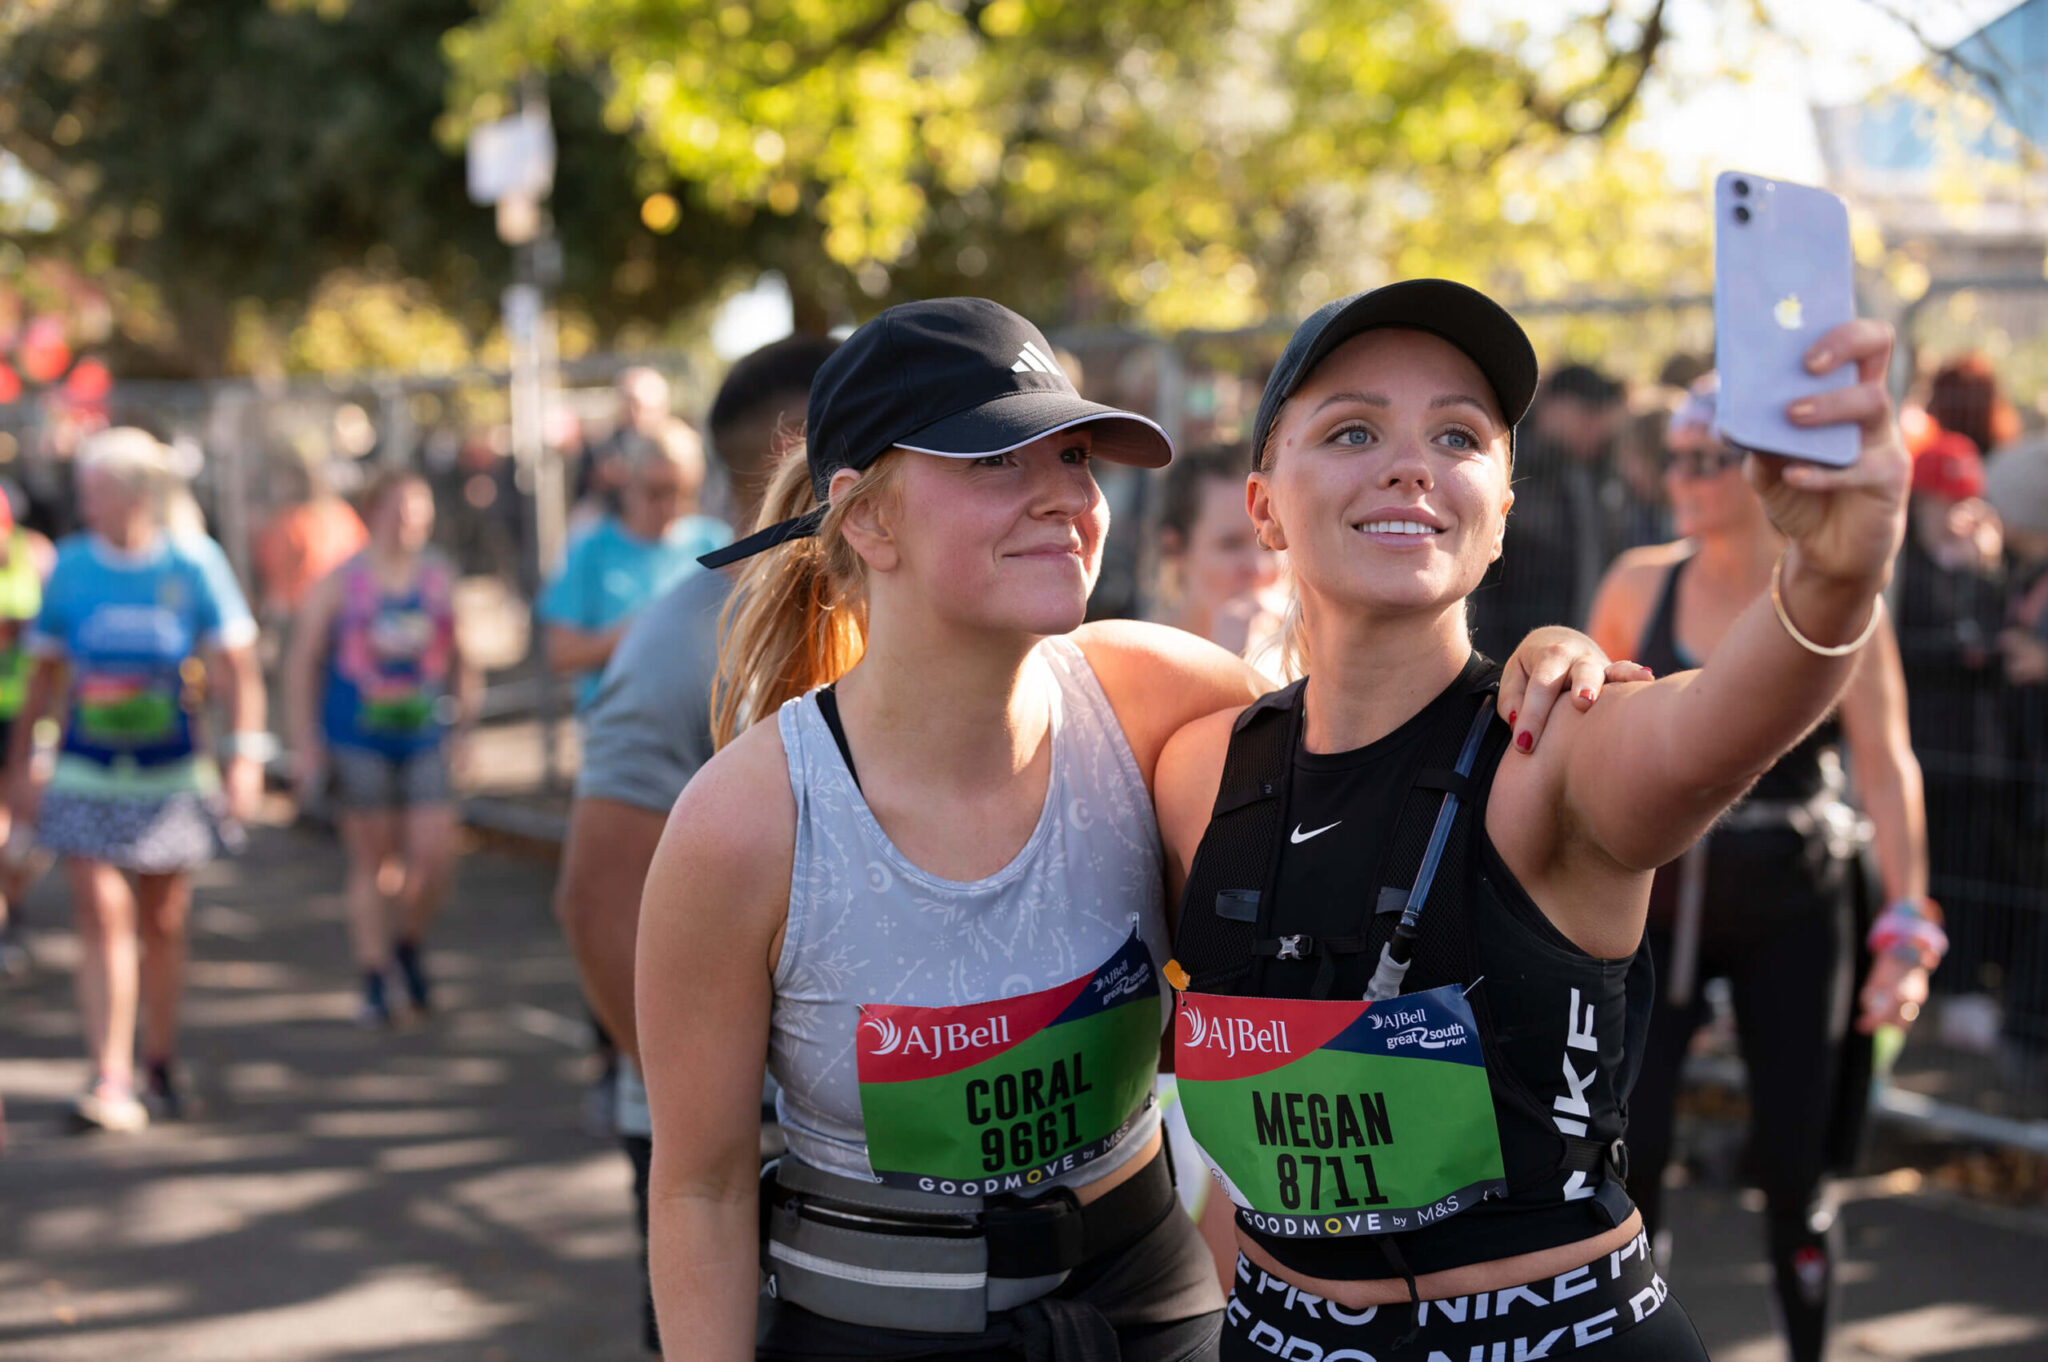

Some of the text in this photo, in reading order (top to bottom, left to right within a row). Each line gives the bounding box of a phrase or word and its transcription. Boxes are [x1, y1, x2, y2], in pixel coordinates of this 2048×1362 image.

[901, 1015, 1011, 1059] AJBell
[1206, 1017, 1291, 1058] AJBell
[1383, 1008, 1427, 1030] AJBell
[1386, 1023, 1465, 1050] great south
[1446, 1037, 1466, 1048] run
[966, 1052, 1092, 1125] CORAL
[981, 1103, 1083, 1172] 9661
[1252, 1090, 1394, 1150] MEGAN
[919, 1121, 1130, 1196] GOODMOVE by M&S
[1276, 1154, 1389, 1211] 8711
[1242, 1195, 1459, 1236] GOODMOVE by M&S
[1418, 1264, 1598, 1328] NIKE
[1247, 1319, 1380, 1362] PR
